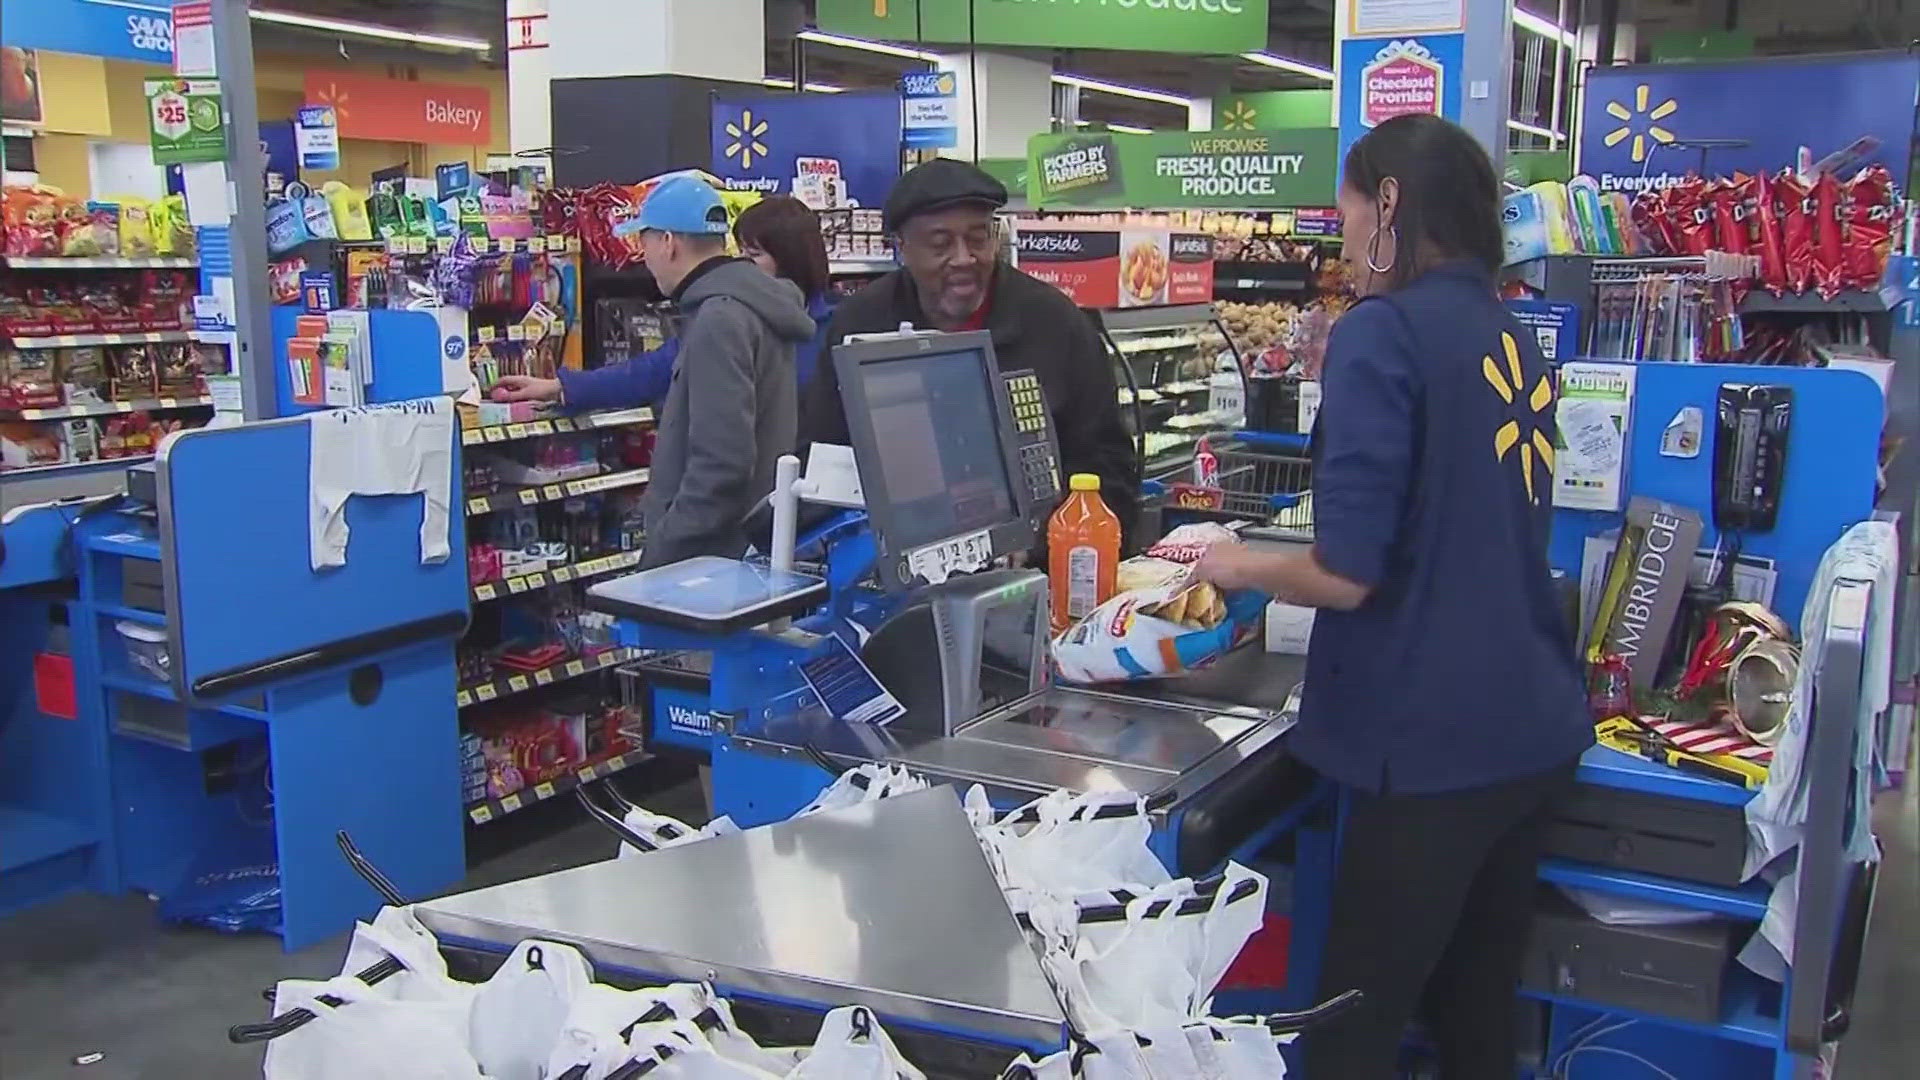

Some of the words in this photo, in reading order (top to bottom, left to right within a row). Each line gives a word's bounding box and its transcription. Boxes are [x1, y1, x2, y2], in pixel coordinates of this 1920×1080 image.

[1368, 75, 1435, 91] Checkout
[1368, 88, 1434, 104] Promise
[157, 106, 186, 124] $25
[426, 100, 482, 132] Bakery
[1190, 139, 1212, 154] WE
[1213, 137, 1269, 153] PROMISE
[799, 160, 838, 175] nutella
[1044, 150, 1087, 171] PICKED
[1088, 145, 1105, 161] BY
[1156, 157, 1218, 177] FRESH,
[1220, 154, 1304, 177] QUALITY
[1045, 160, 1108, 185] FARMERS
[725, 177, 779, 193] Everyday
[1181, 176, 1276, 196] PRODUCE.
[1616, 512, 1680, 672] AMBRIDGE
[668, 705, 711, 729] Walm
